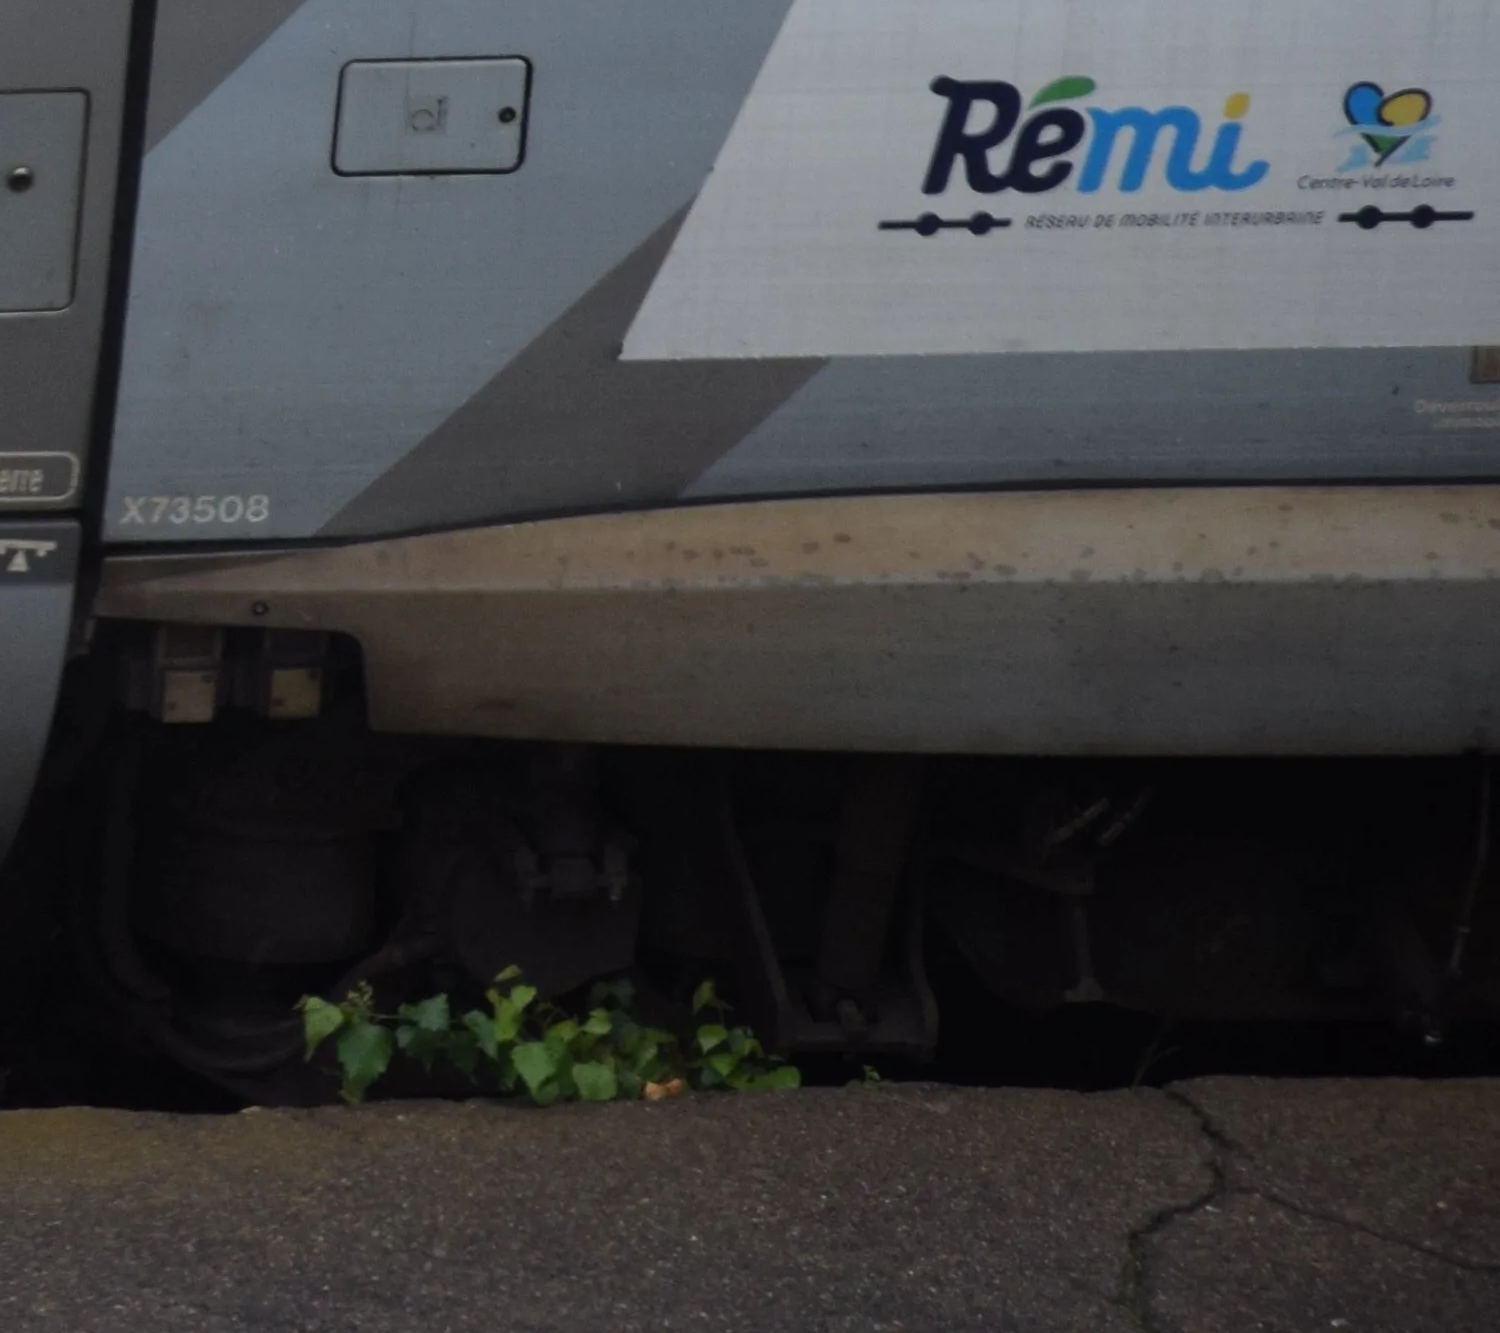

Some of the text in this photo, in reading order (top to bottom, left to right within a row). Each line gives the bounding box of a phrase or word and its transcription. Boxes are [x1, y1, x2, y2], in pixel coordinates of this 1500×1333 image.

[922, 75, 1270, 196] Rémi
[1297, 175, 1390, 190] Centre-Val
[1412, 174, 1456, 188] Loire
[1093, 213, 1114, 229] DE
[118, 494, 270, 525] X73508
